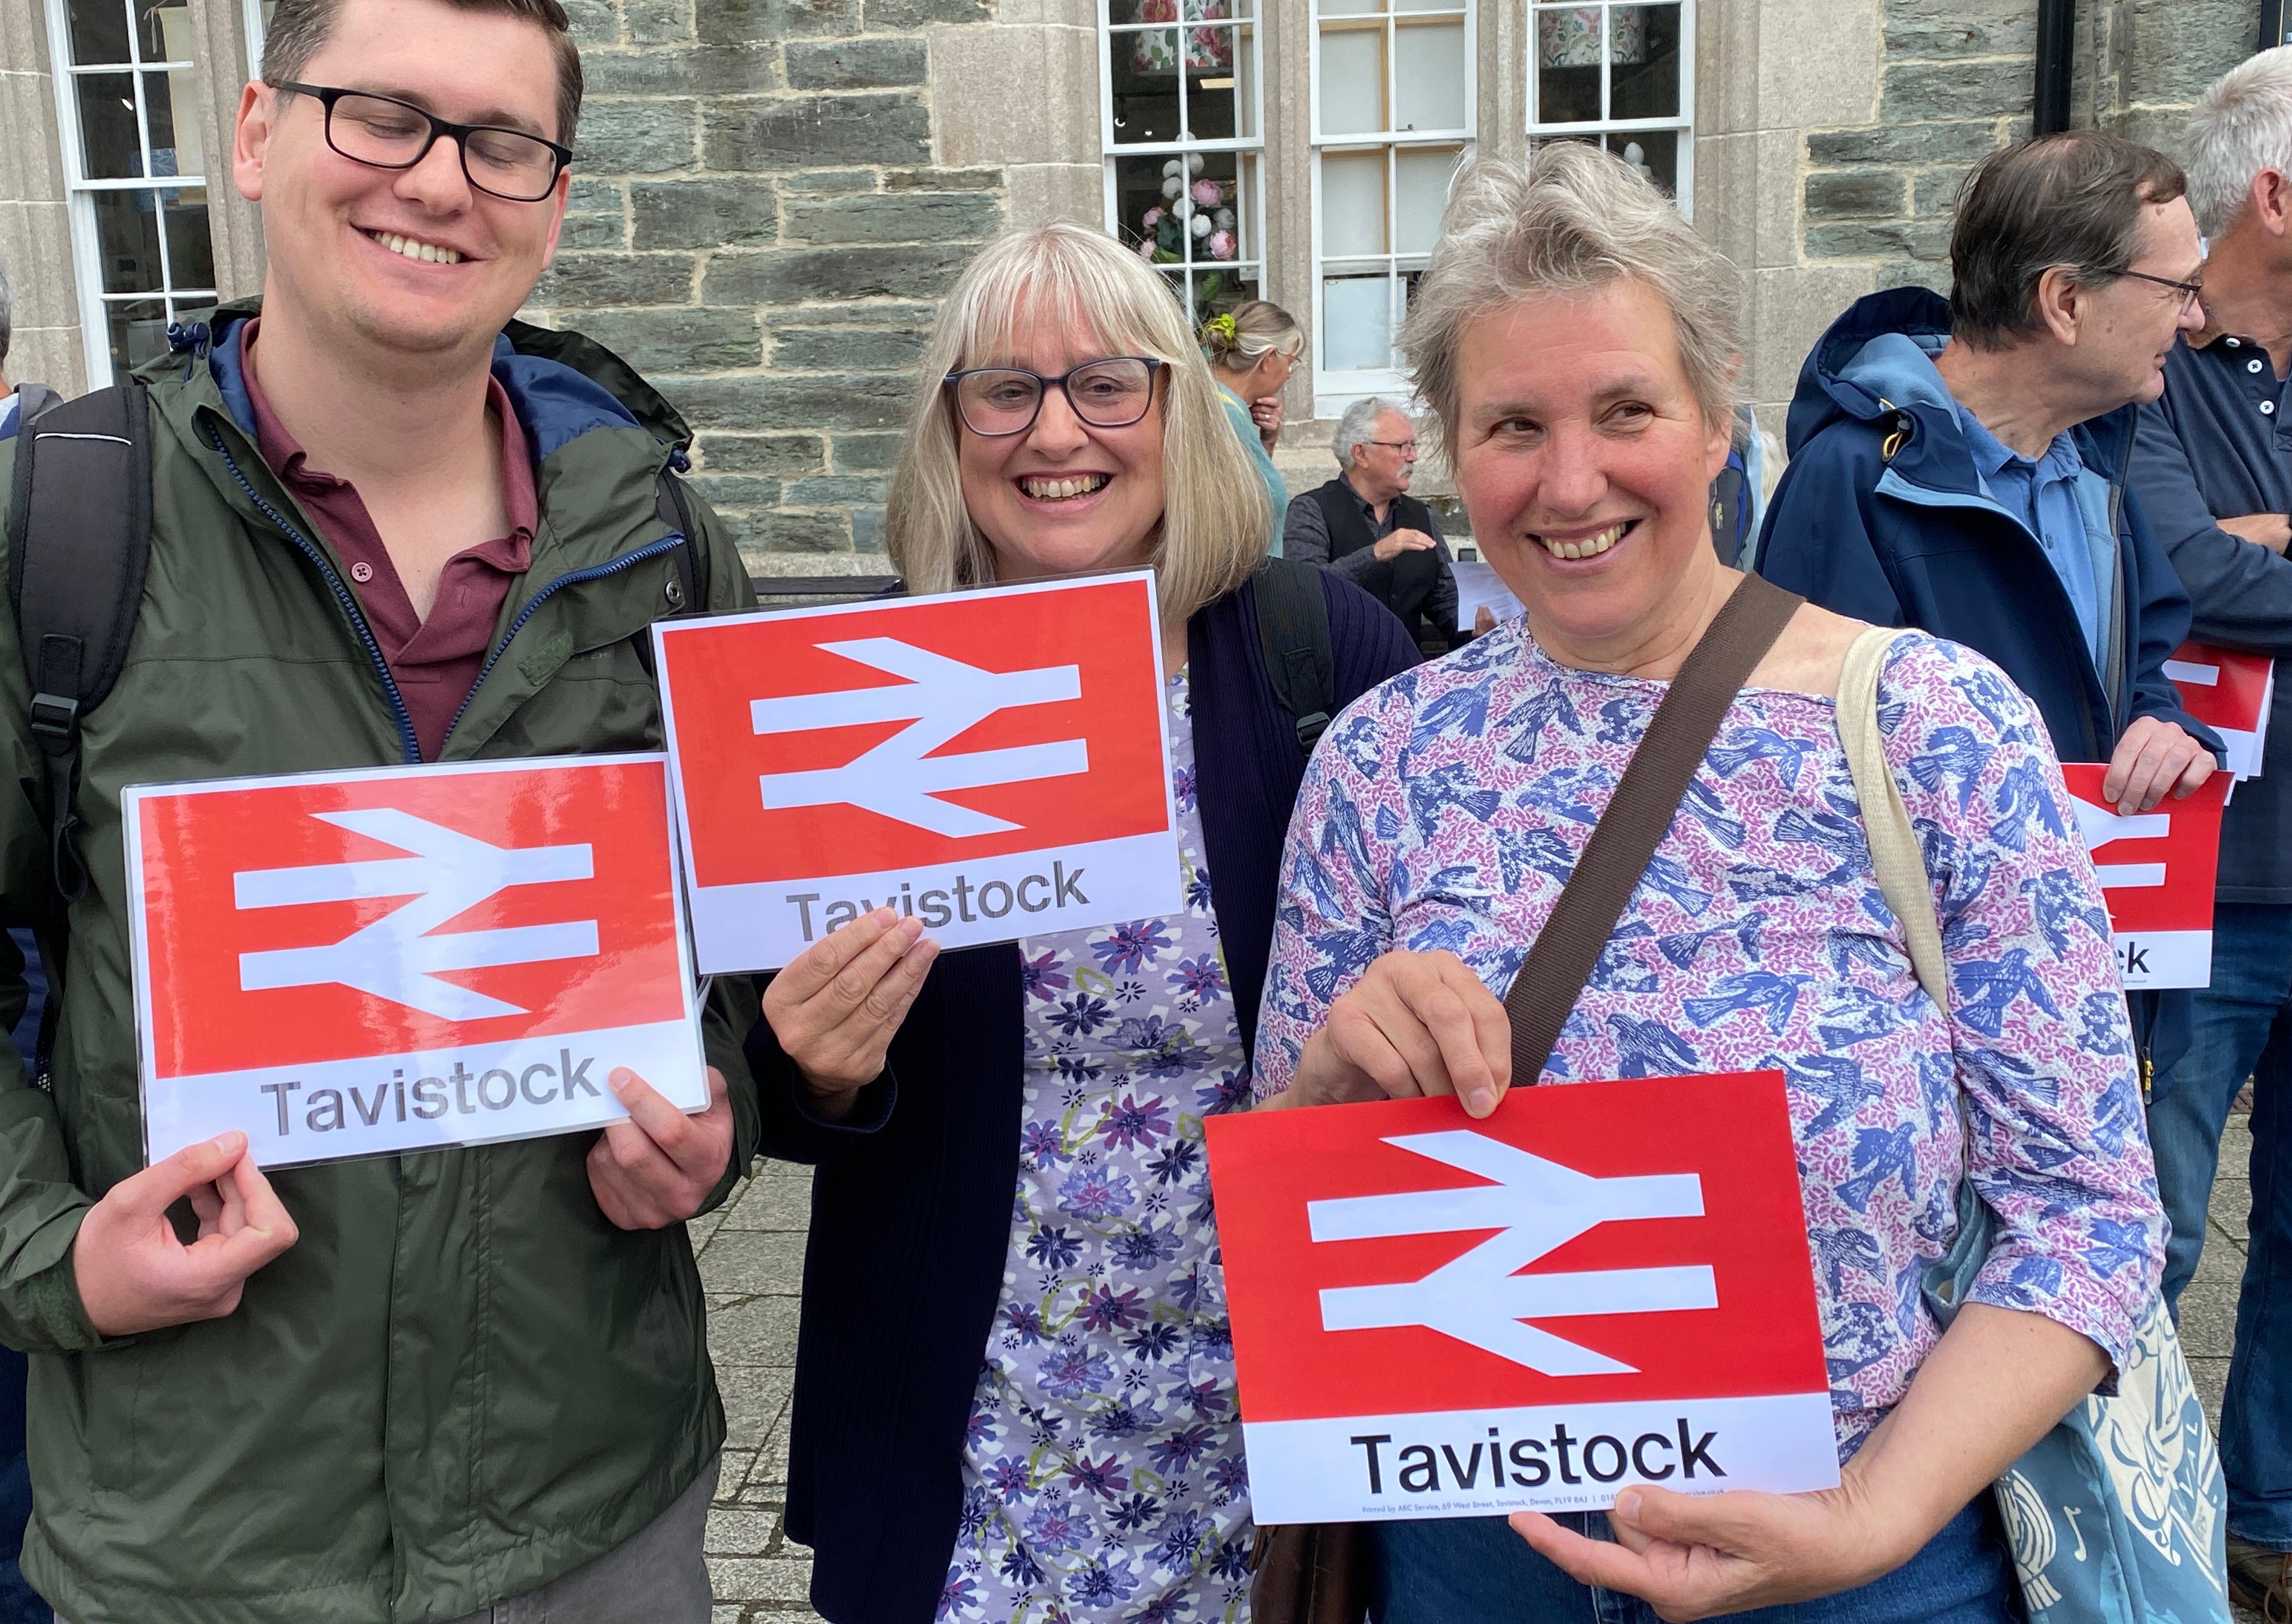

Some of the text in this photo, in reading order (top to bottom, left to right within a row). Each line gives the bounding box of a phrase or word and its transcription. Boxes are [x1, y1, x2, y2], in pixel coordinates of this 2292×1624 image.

[260, 1048, 602, 1136] Tavistock
[1350, 1417, 1728, 1495] Tavistock
[1387, 1504, 1396, 1514] by
[1496, 1498, 1529, 1507] Tavistock,
[1530, 1497, 1553, 1506] Devon,
